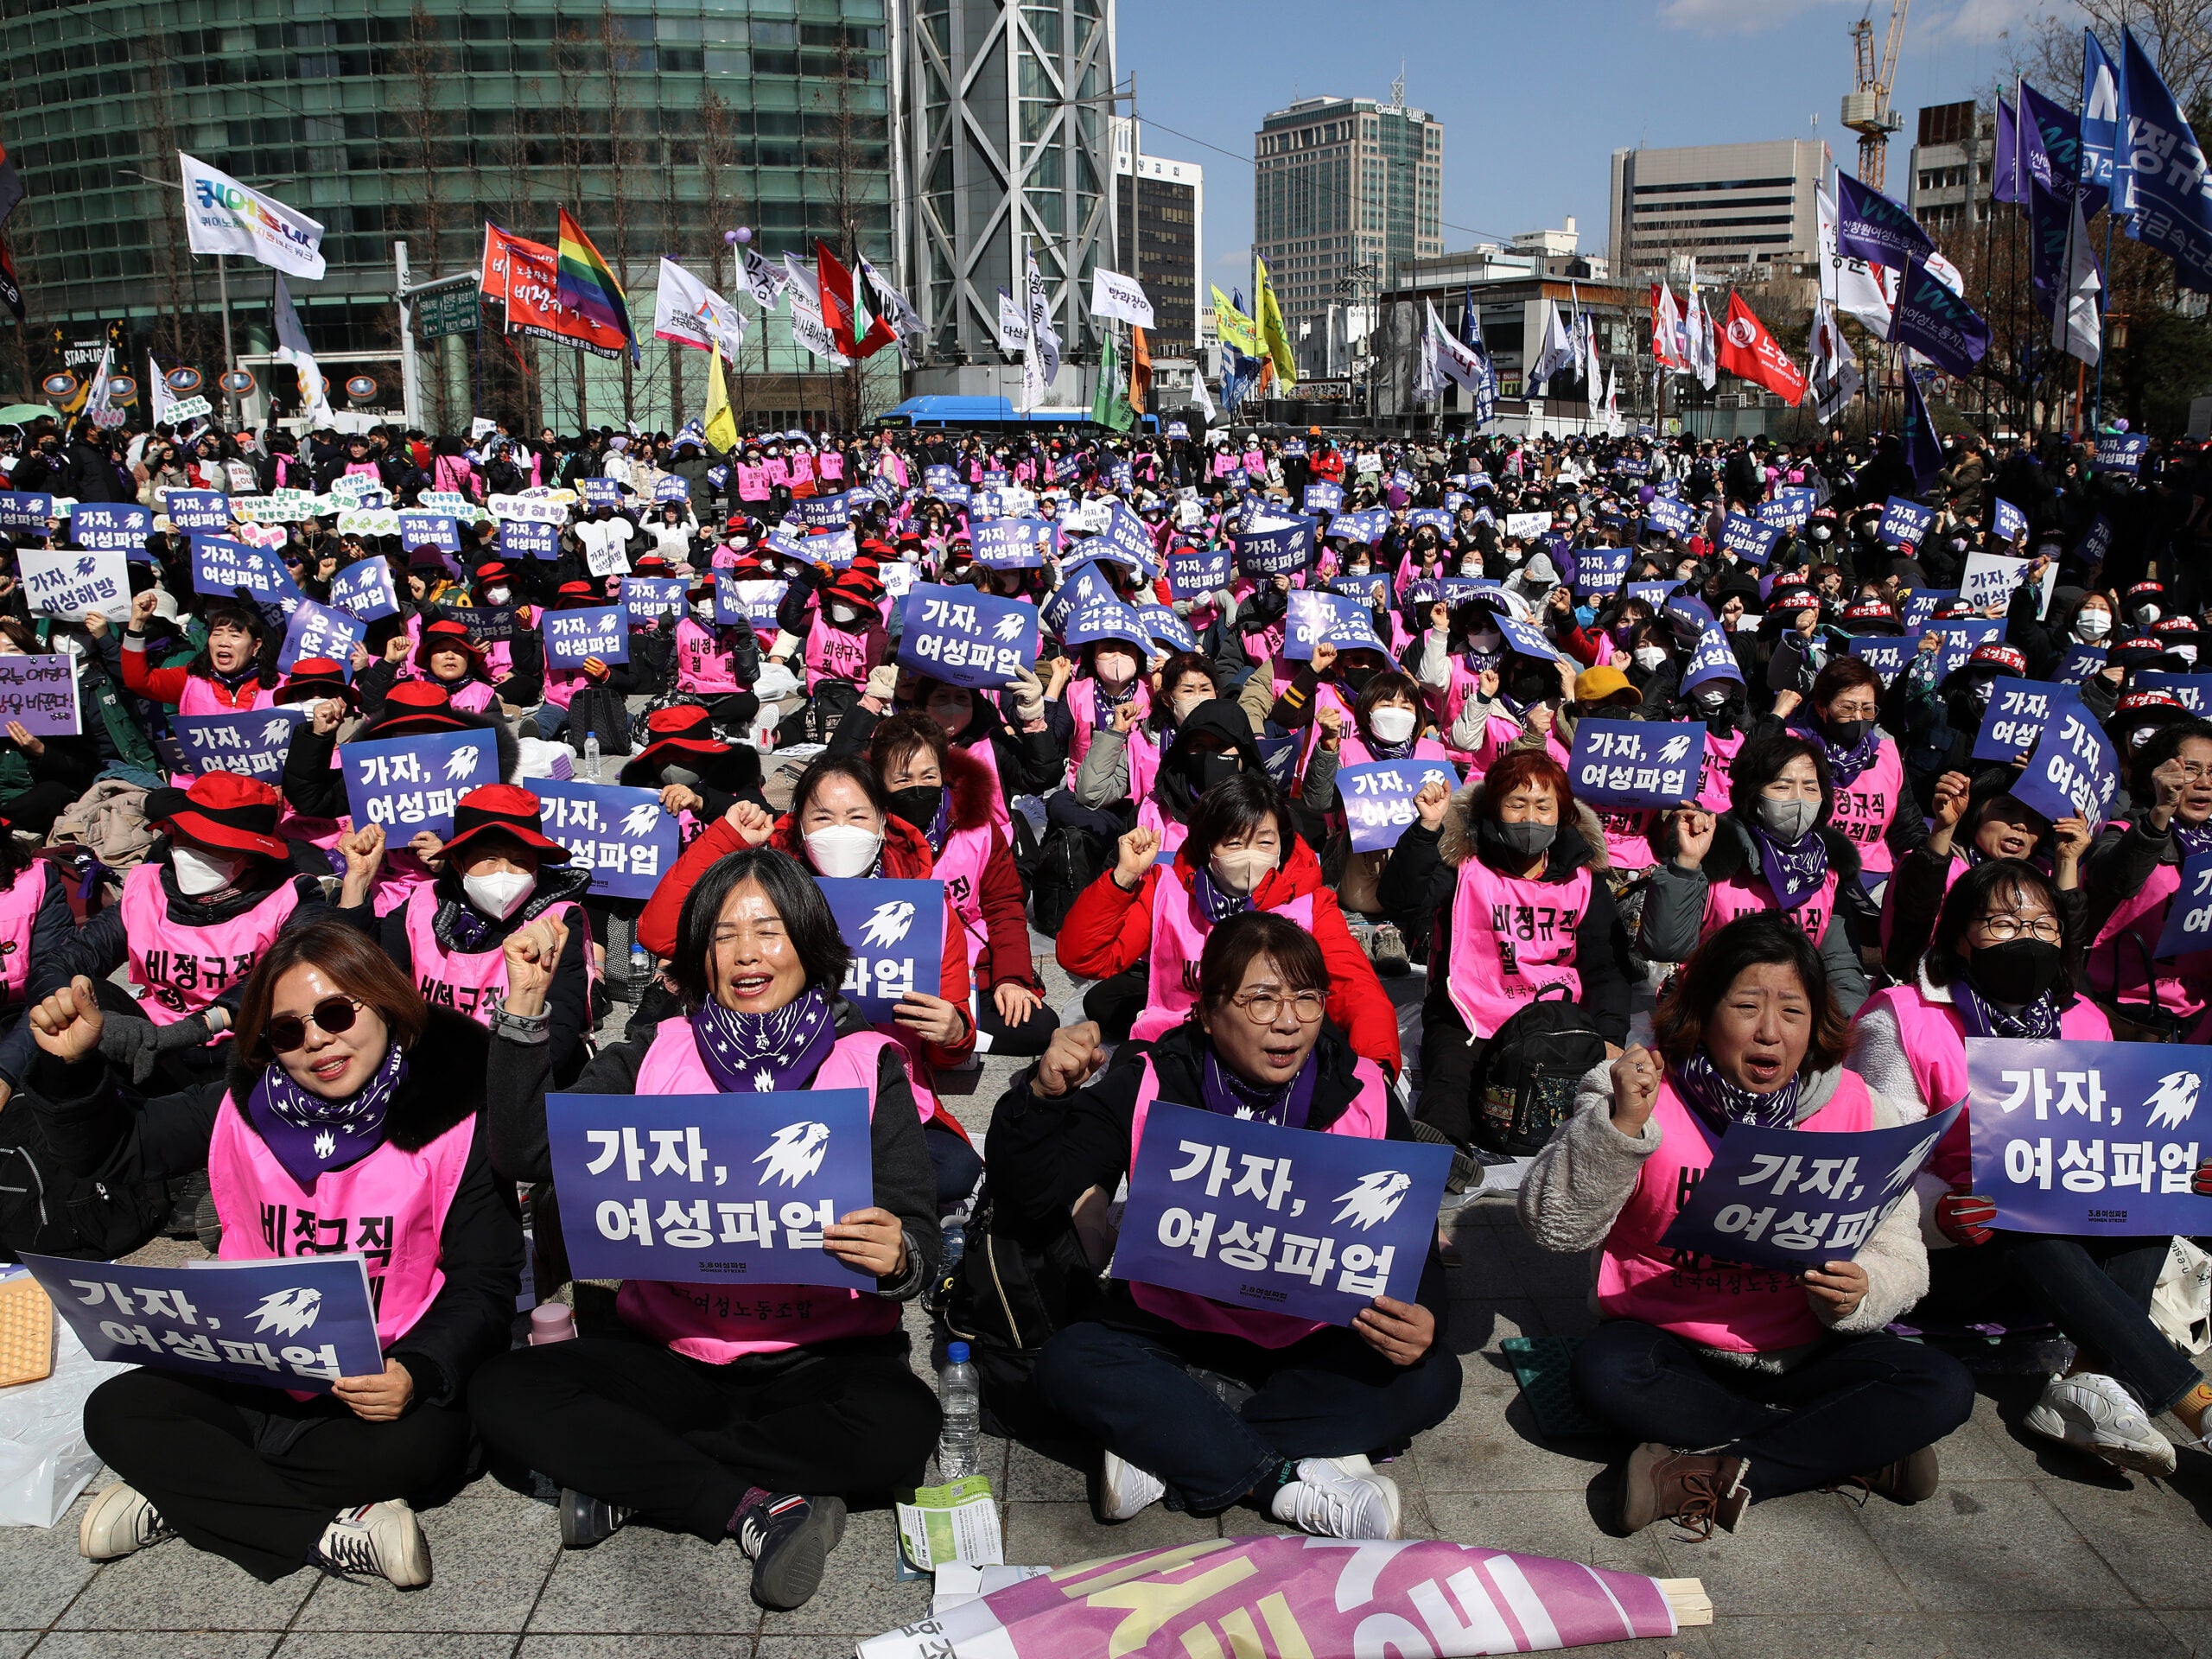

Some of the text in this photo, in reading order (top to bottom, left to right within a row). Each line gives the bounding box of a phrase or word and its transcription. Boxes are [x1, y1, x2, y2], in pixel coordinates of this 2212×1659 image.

[2100, 438, 2120, 450] 가자,
[2095, 453, 2138, 466] 여성파업
[276, 489, 301, 500] 남녀
[1307, 489, 1325, 499] 가자,
[1307, 499, 1339, 509] 여성파업
[0, 499, 21, 512] 자,
[174, 499, 203, 512] 가자,
[804, 502, 829, 514] 가자,
[1657, 502, 1680, 517] 가자,
[1763, 504, 1788, 517] 가자,
[1889, 504, 1918, 524] 가자,
[0, 513, 46, 526] 성파업
[79, 511, 118, 528] 가자,
[175, 513, 228, 527] 여성파업
[405, 520, 432, 531] 가자,
[806, 513, 847, 524] 여성파업
[1119, 512, 1141, 538] 가자,
[1656, 515, 1686, 532] 여성파업
[1728, 519, 1752, 537] 가자,
[1764, 514, 1807, 529] 여성파업
[408, 532, 453, 543] 여성파업
[506, 524, 533, 536] 가자,
[977, 529, 1009, 543] 가자,
[1885, 519, 1923, 543] 여성파업
[79, 532, 148, 549] 여성파업
[506, 537, 551, 551] 여성파업
[1114, 530, 1154, 562] 여성파업
[1244, 539, 1282, 554] 가자,
[1723, 534, 1767, 556] 여성파업
[200, 545, 240, 567] 가자,
[980, 543, 1034, 559] 여성파업
[1246, 550, 1306, 572] 여성파업
[1174, 560, 1205, 573] 가자,
[1580, 557, 1607, 570] 가자,
[29, 567, 73, 593] 가자,
[202, 567, 270, 591] 여성파업
[1176, 574, 1224, 589] 여성파업
[1580, 572, 1624, 587] 여성파업
[1970, 570, 2011, 588] 가자,
[41, 577, 118, 615] 여성해방
[628, 584, 661, 601] 가자,
[922, 598, 982, 637] 가자,
[1078, 606, 1129, 622] 가자,
[552, 618, 591, 635] 가자,
[1078, 620, 1153, 647] 여성파업
[554, 636, 620, 657] 여성파업
[915, 633, 1022, 675] 여성파업
[2000, 691, 2050, 721] 가자,
[2168, 686, 2205, 710] 자,
[189, 727, 251, 750] 가자,
[1586, 732, 1647, 761] 가자,
[2060, 714, 2101, 780] 가자,
[359, 753, 431, 786] 가자,
[1581, 764, 1686, 795] 여성파업
[1351, 770, 1413, 796] 가자,
[1833, 791, 1886, 819] 정규직
[540, 797, 607, 834] 가자,
[1491, 902, 1576, 943] 비정규직
[1999, 1068, 2123, 1127] 가자,
[585, 1126, 728, 1187] 가자,
[2004, 1138, 2199, 1195] 여성파업
[1169, 1139, 1306, 1217] 가자,
[1737, 1153, 1864, 1201] 가자,
[594, 1198, 836, 1250] 여성파업
[1157, 1207, 1395, 1299] 여성파업
[68, 1278, 222, 1332] 가자,
[98, 1319, 343, 1380] 여성파업
